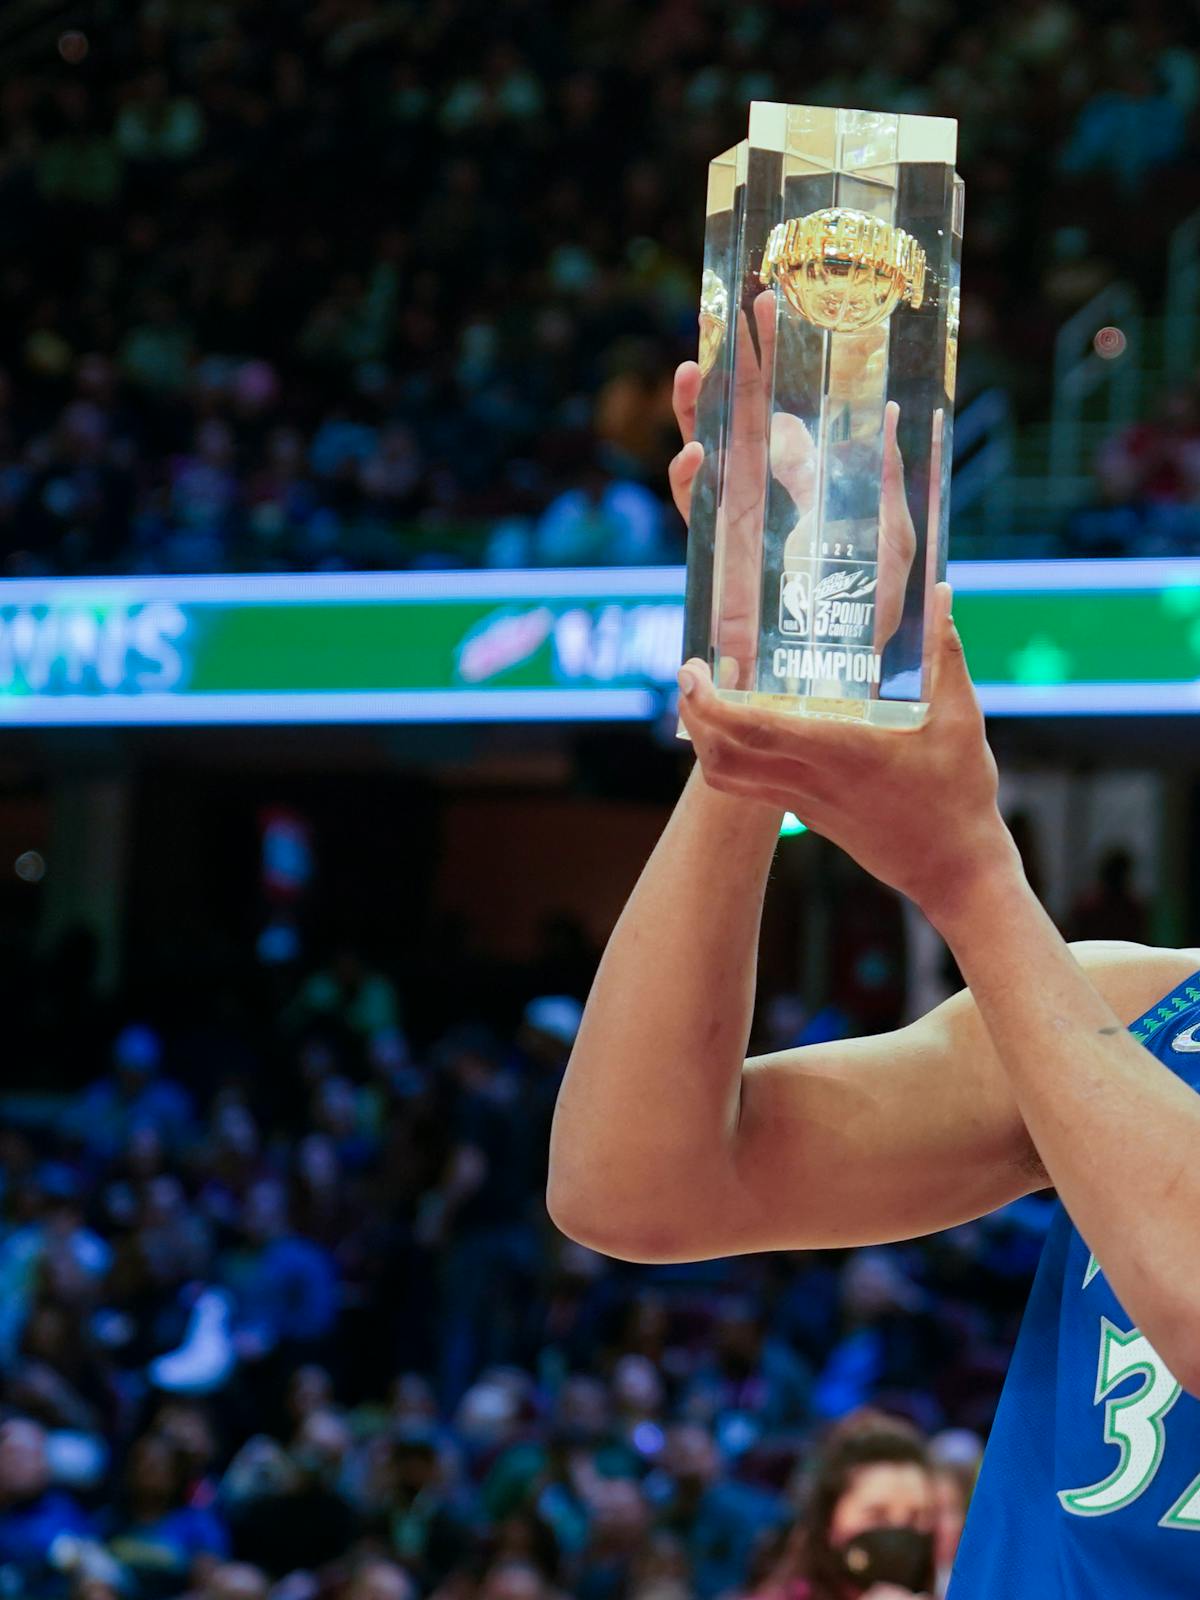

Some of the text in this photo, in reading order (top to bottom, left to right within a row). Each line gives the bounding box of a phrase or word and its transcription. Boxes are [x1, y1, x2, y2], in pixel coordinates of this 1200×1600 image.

[809, 541, 855, 557] 2022
[828, 623, 864, 637] CONTEST
[772, 647, 882, 683] CHAMPION
